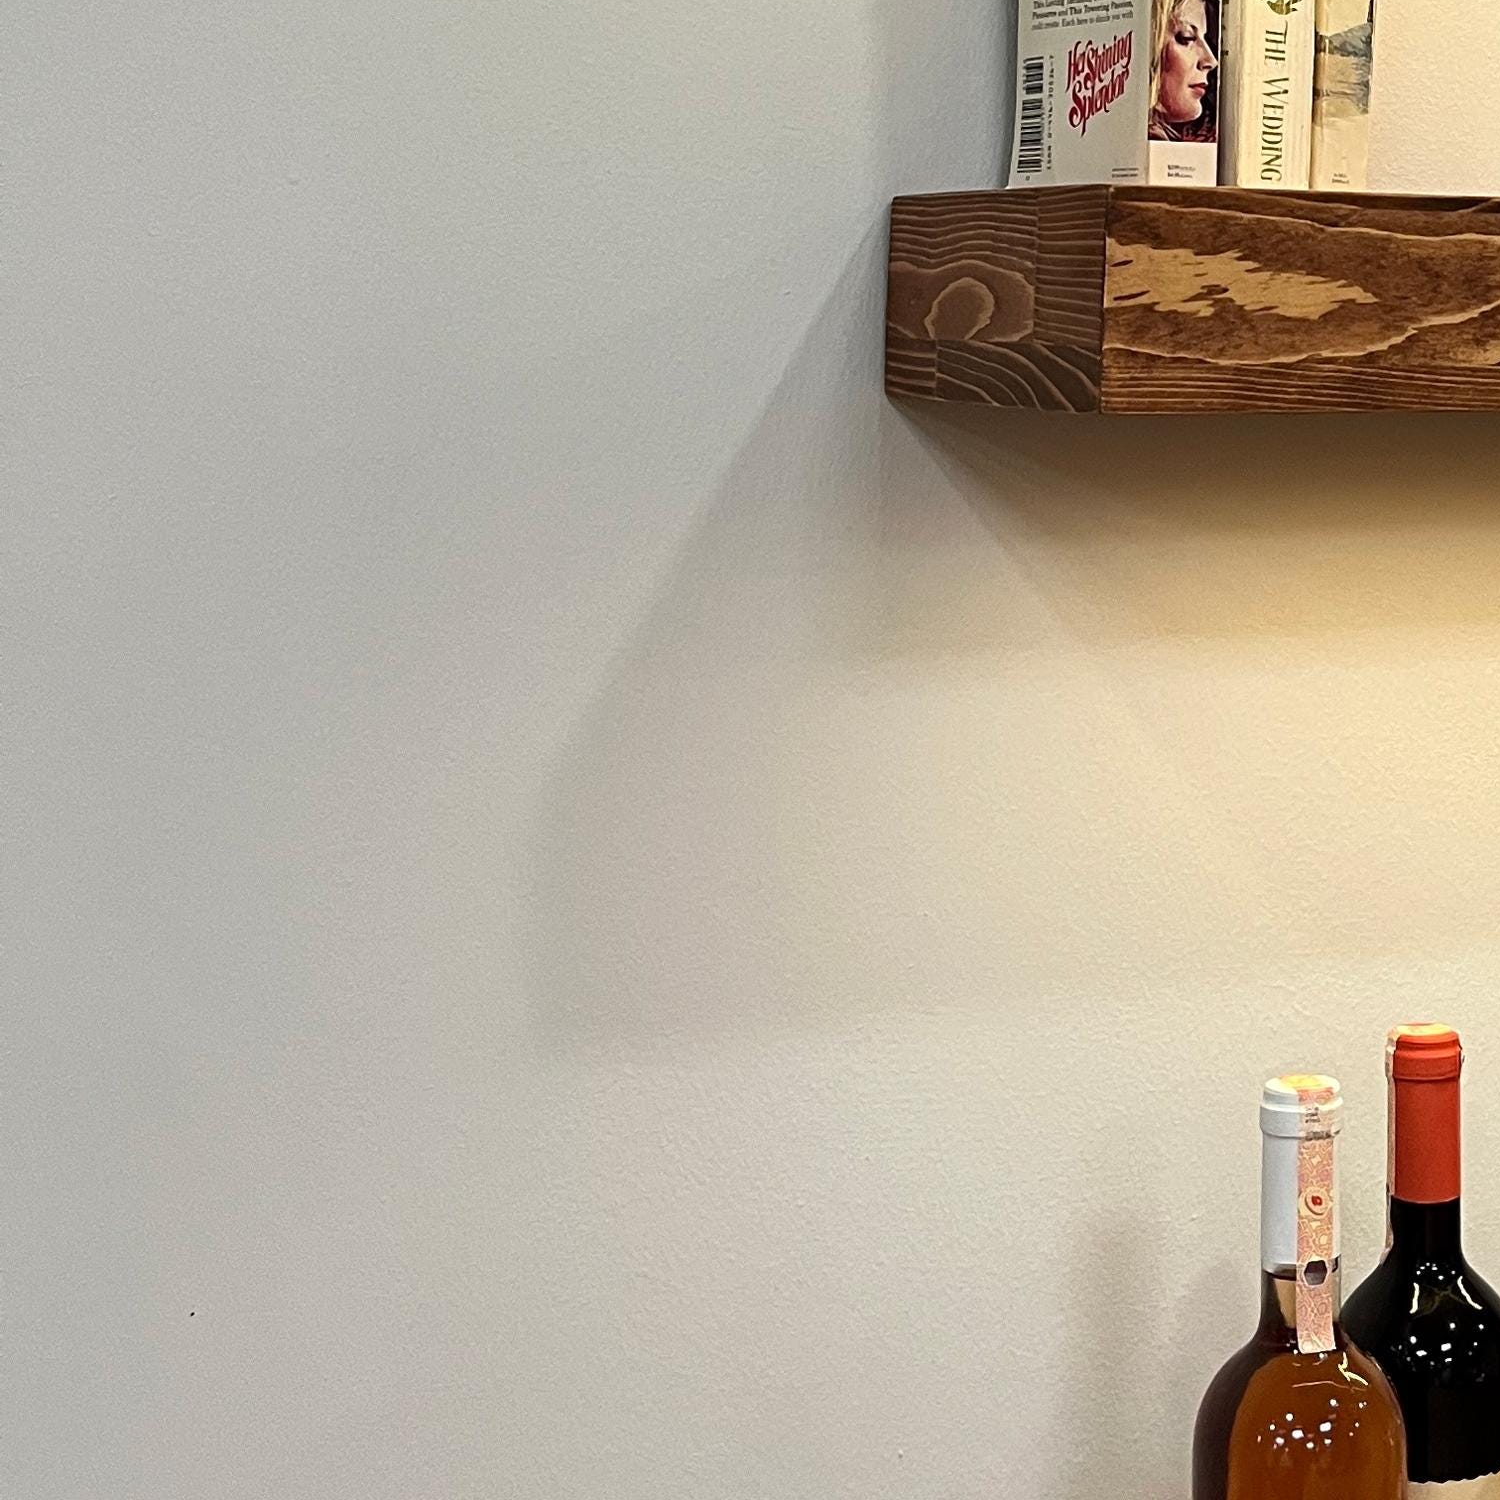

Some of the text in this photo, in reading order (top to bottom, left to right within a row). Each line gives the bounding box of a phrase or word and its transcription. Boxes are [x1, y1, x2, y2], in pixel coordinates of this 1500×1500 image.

[1066, 30, 1133, 93] Her Shining
[1069, 67, 1130, 138] Splendor
[1260, 20, 1290, 183] THE WEDDING
